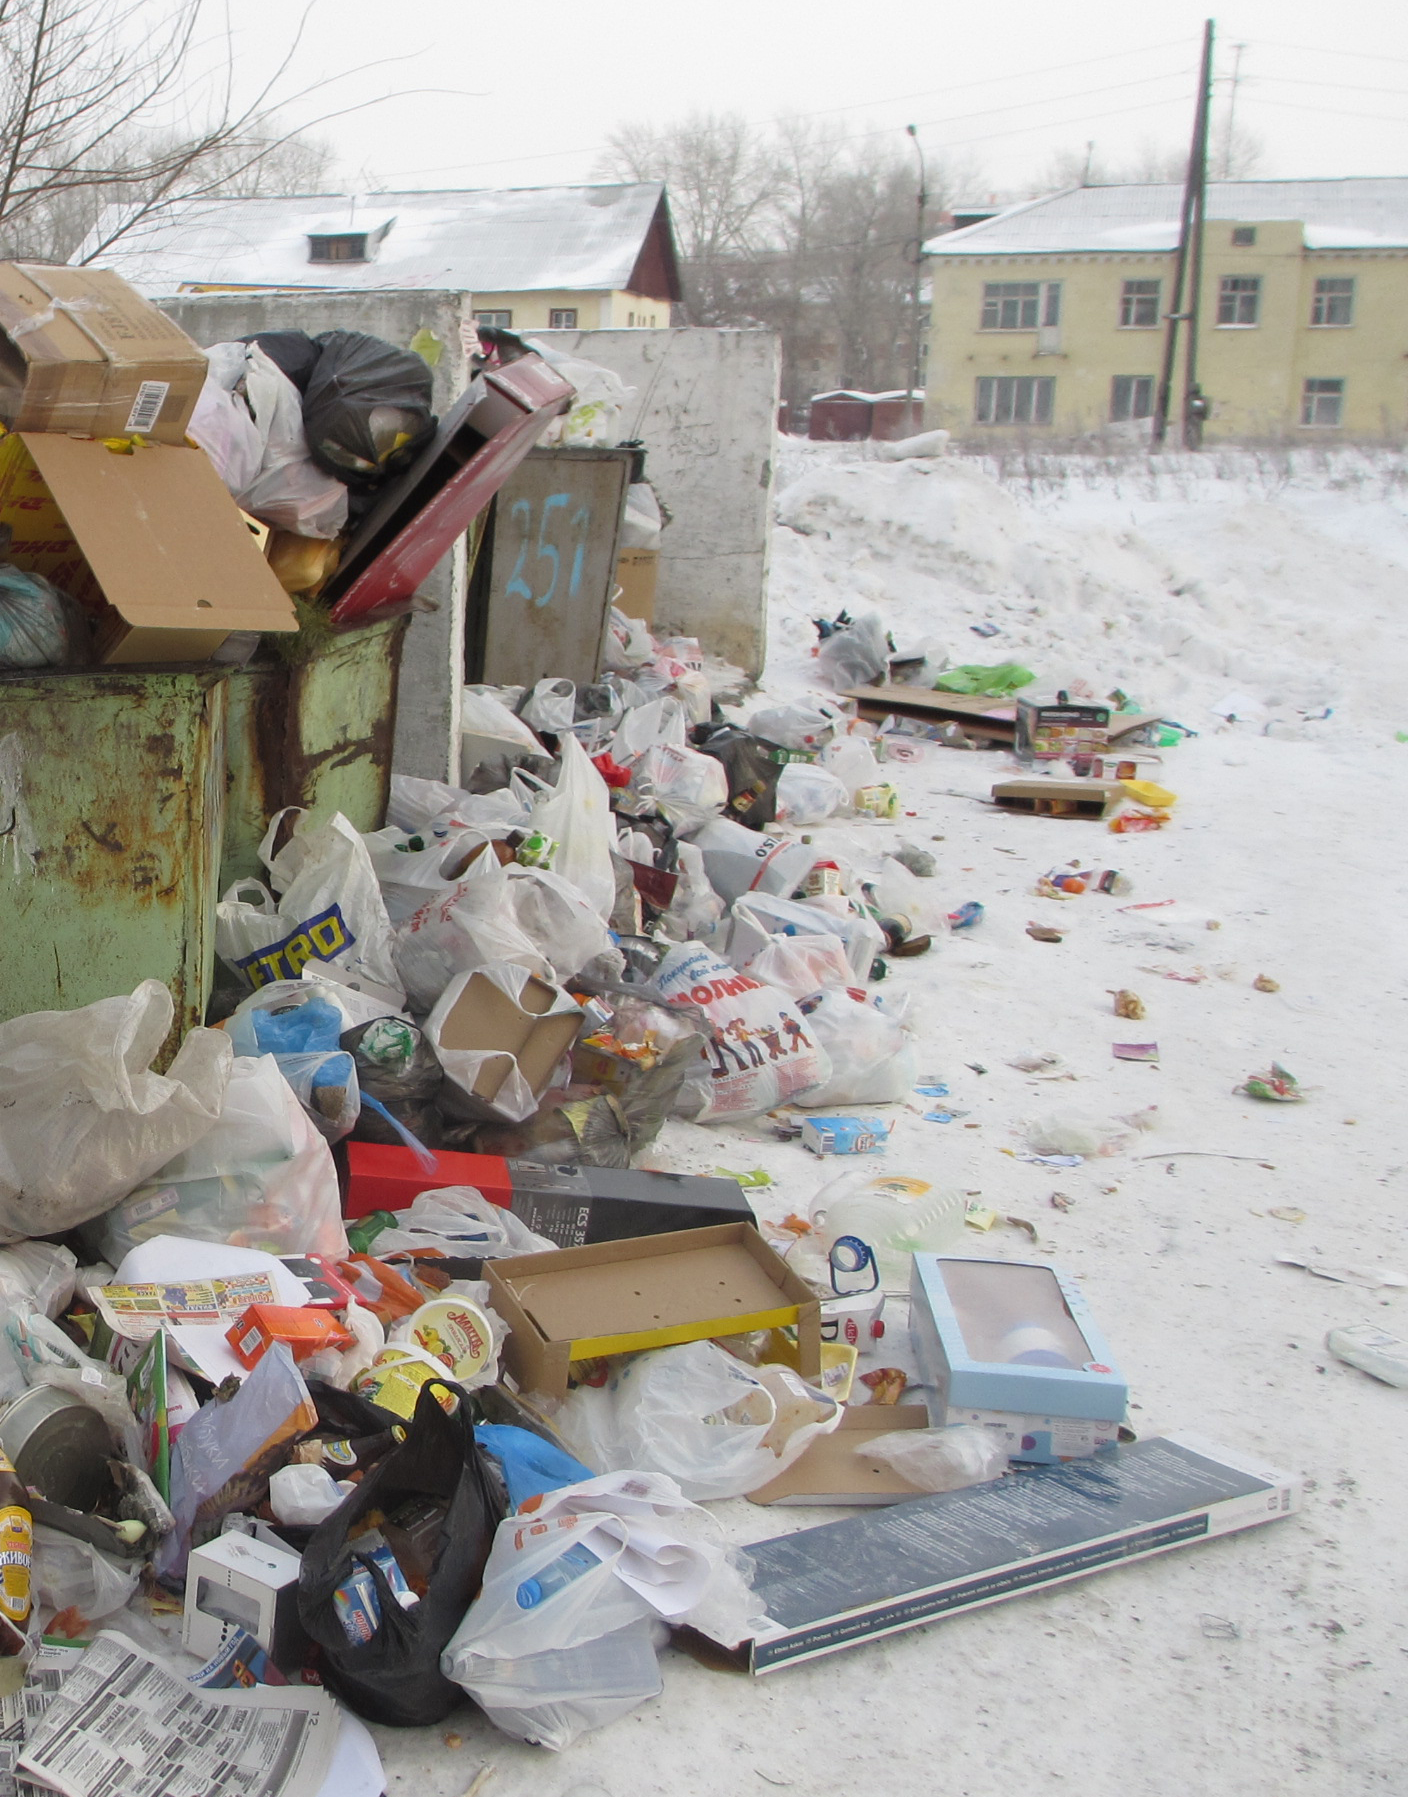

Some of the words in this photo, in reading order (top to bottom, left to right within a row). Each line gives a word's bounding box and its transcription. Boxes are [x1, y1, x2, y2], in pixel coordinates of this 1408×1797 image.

[504, 492, 590, 607] 251
[246, 914, 346, 990] ETRO
[578, 1205, 590, 1229] ECS
[351, 1608, 373, 1642] МОЛОК
[213, 1646, 231, 1668] НОВЫЙ
